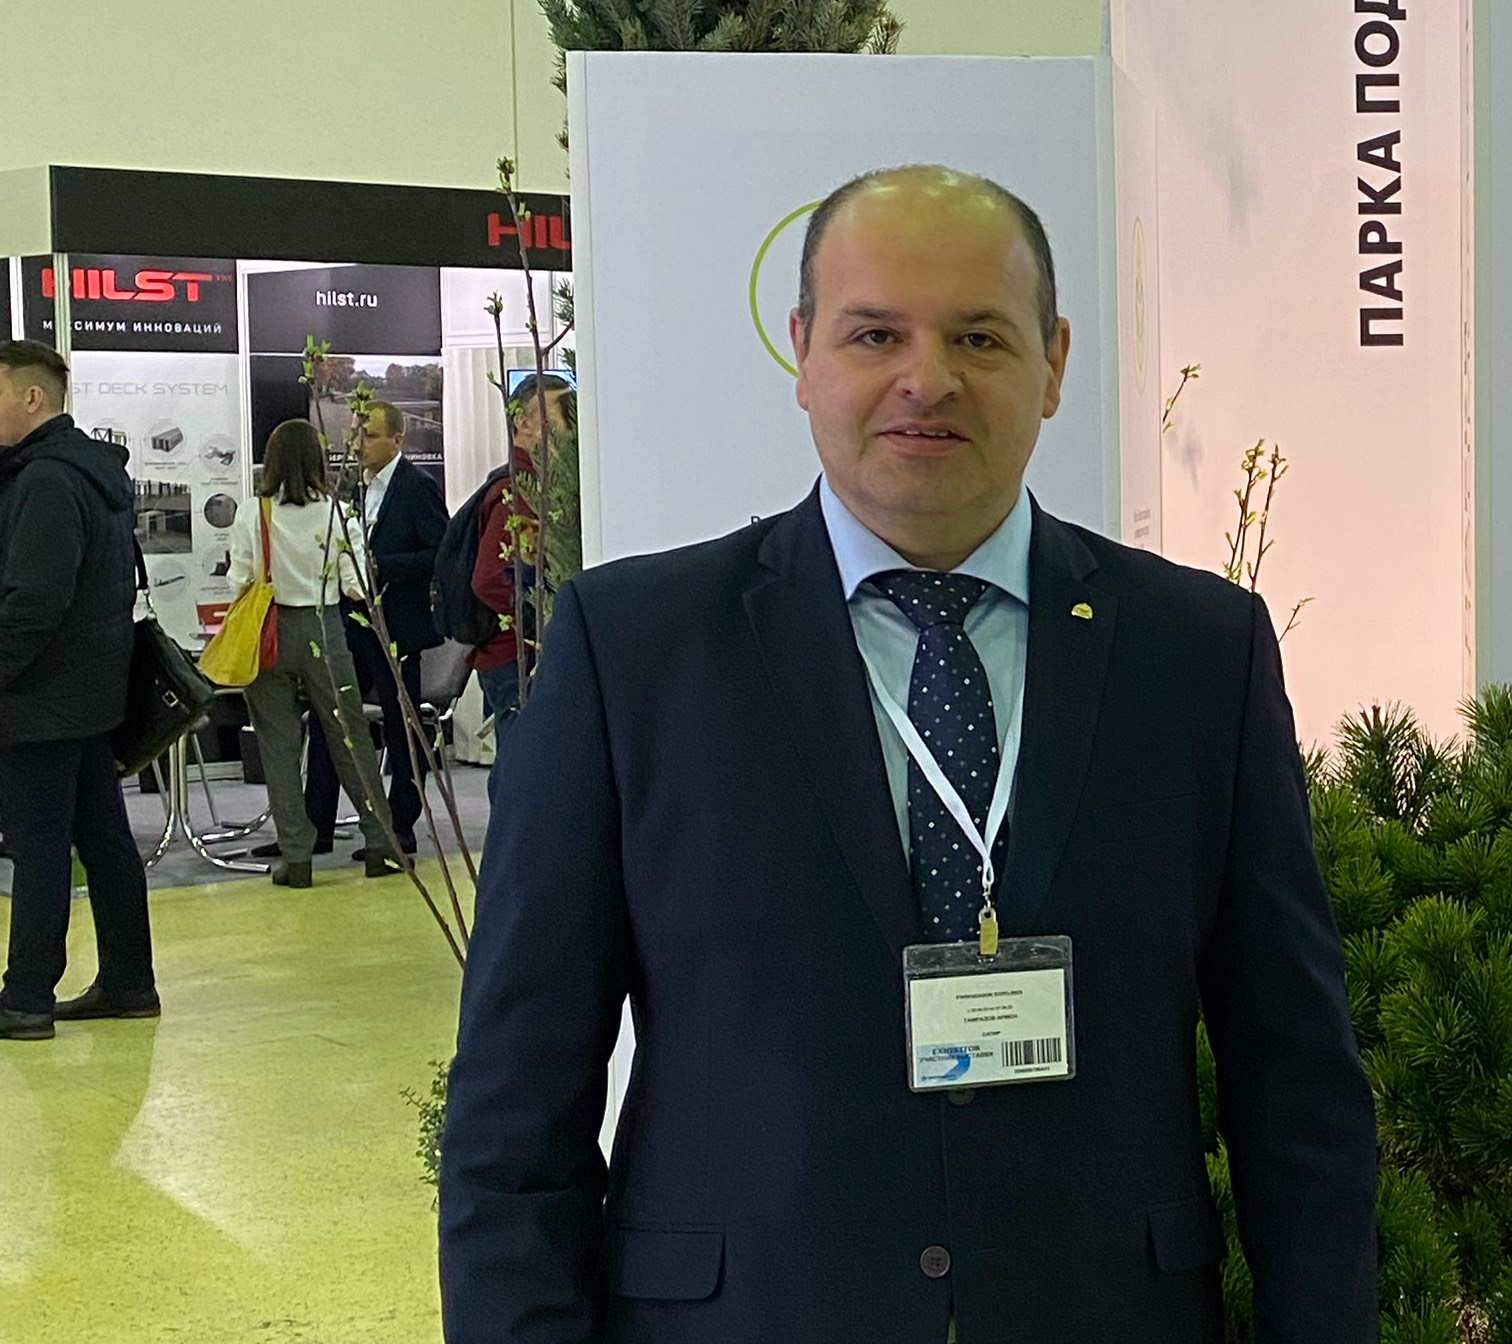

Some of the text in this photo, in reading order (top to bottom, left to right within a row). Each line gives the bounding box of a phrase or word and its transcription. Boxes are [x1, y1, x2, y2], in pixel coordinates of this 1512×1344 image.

[1356, 128, 1405, 348] ПАРКА
[315, 290, 378, 308] hilst.ru
[42, 320, 223, 334] МСИМУМ ИННОВАЦИЙ
[98, 382, 147, 395] DECK
[152, 382, 229, 396] SYSTEM
